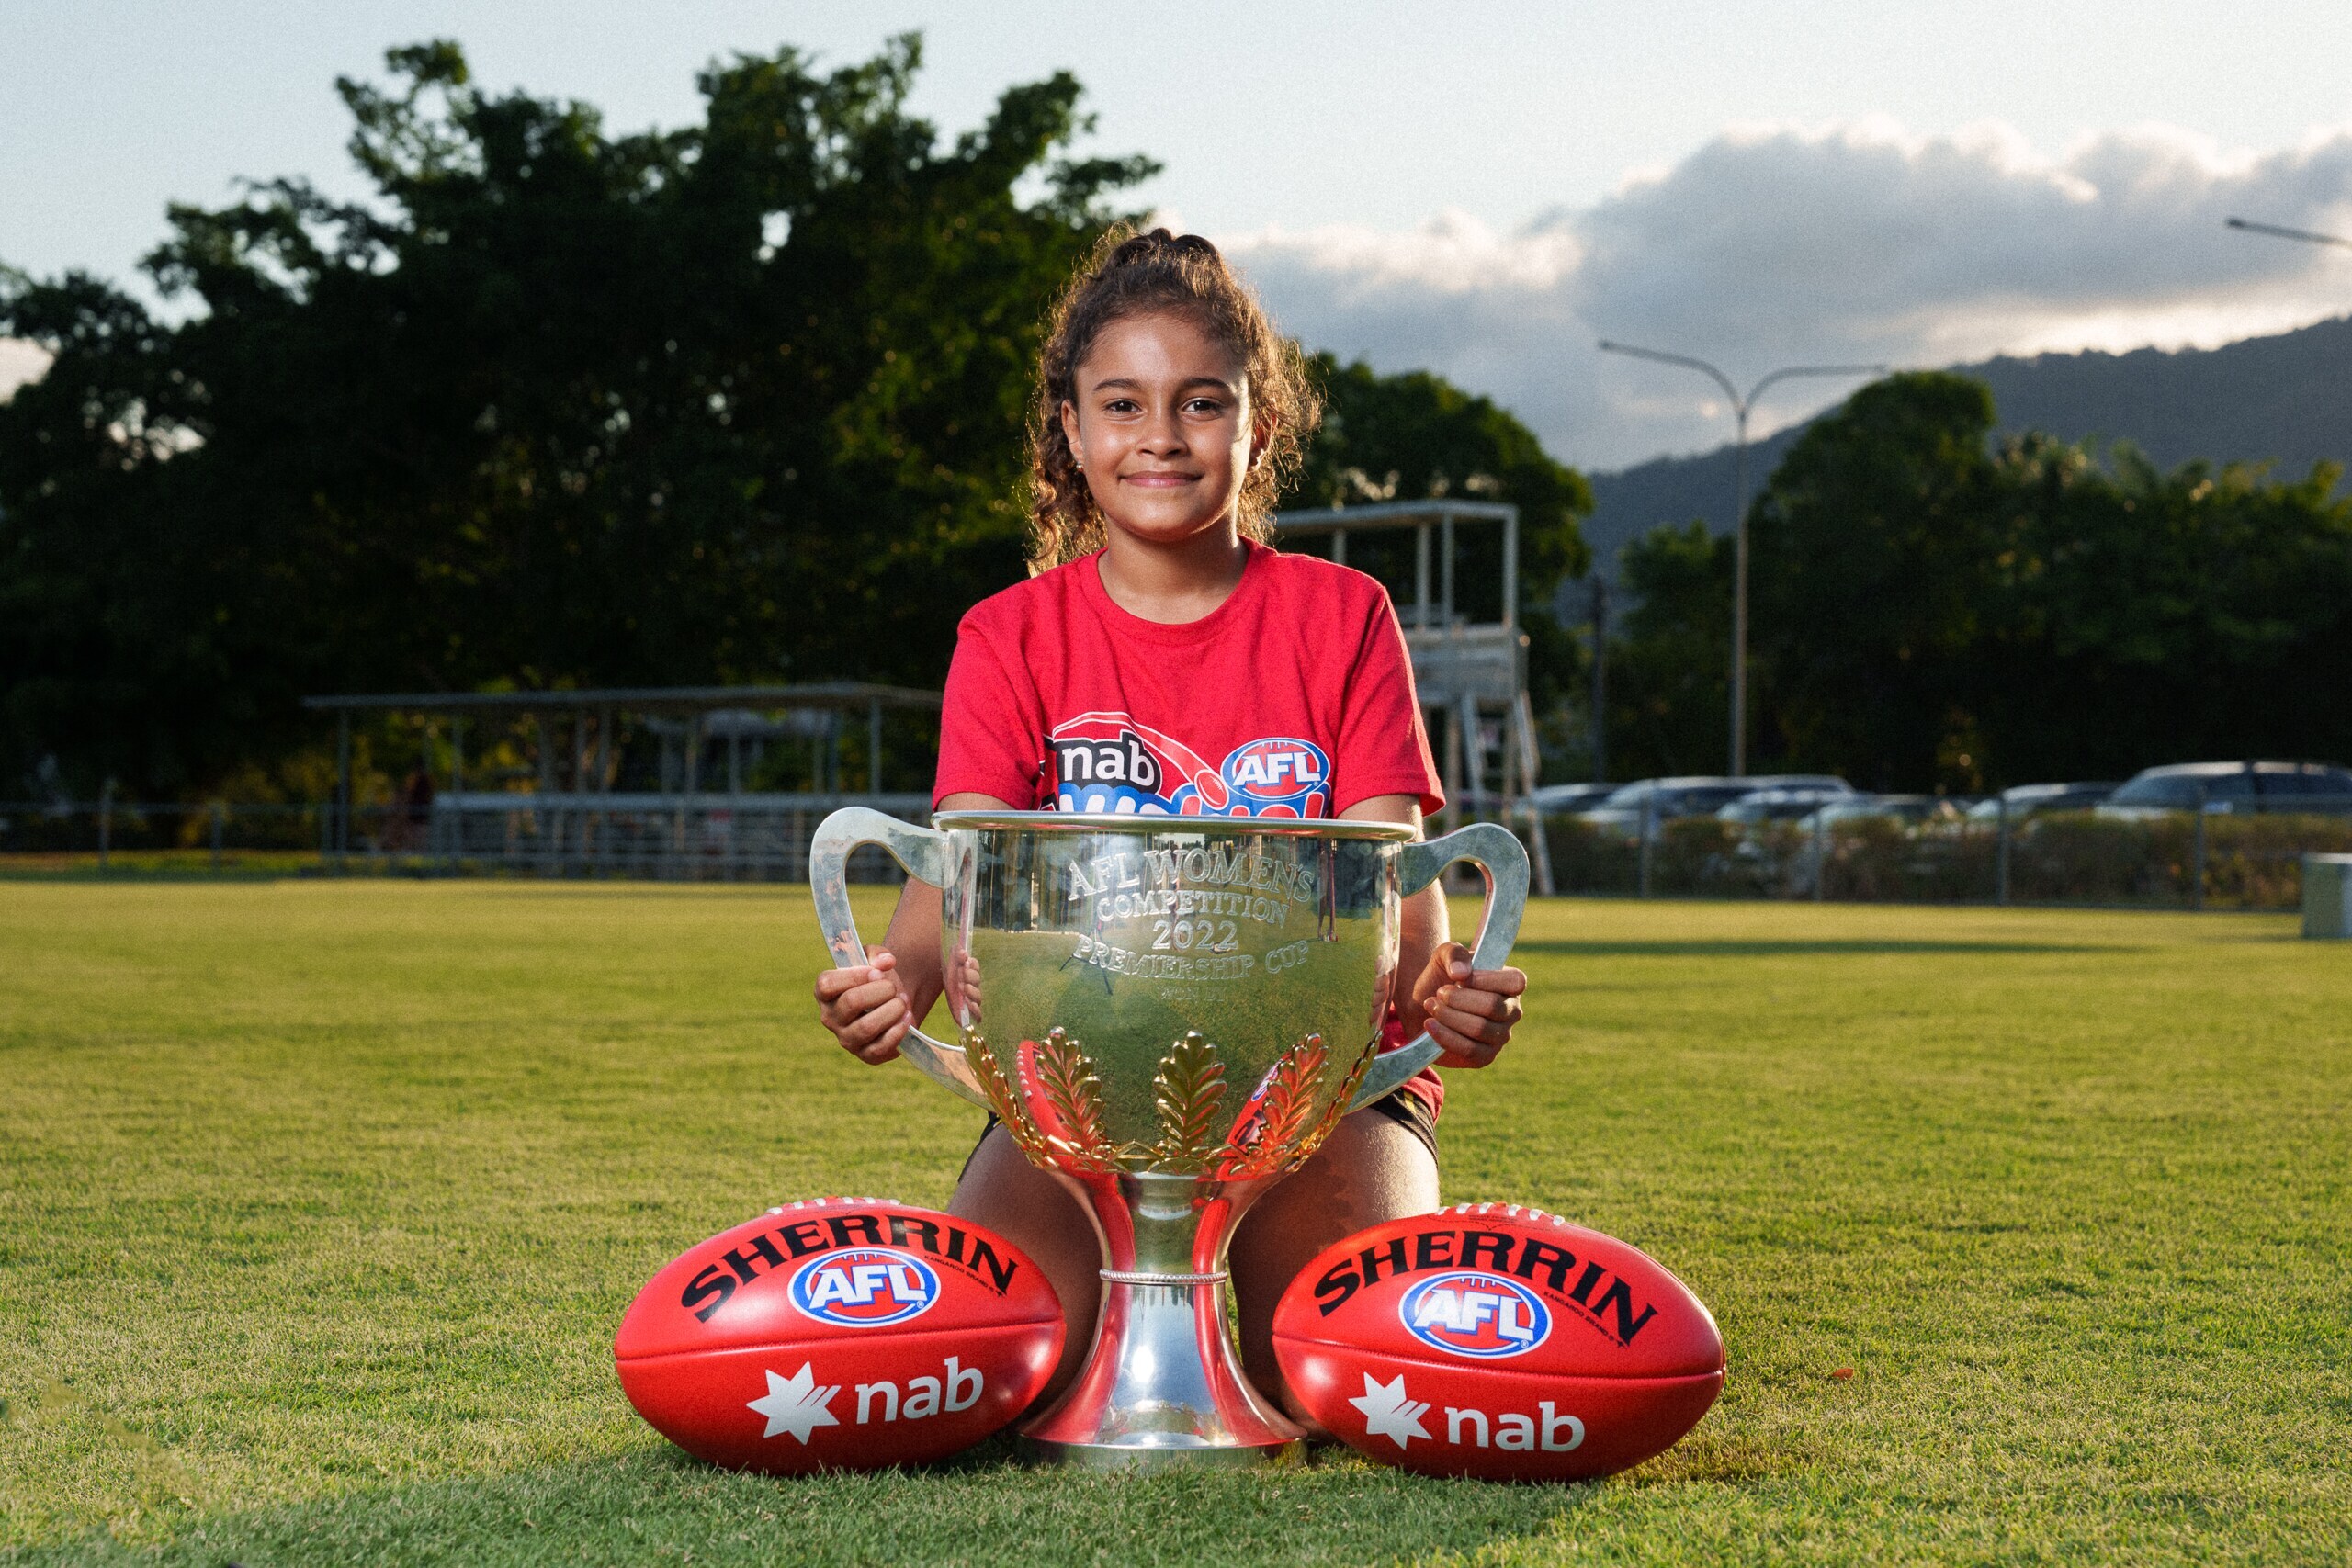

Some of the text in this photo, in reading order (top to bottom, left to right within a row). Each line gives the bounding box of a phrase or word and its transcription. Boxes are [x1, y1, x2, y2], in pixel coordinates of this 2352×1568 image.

[1060, 742, 1155, 786] nab
[1232, 751, 1321, 786] AFL
[1068, 848, 1314, 903] AFL WOMEN'S
[1097, 890, 1289, 928] COMPETITION
[1073, 933, 1308, 981] PREMIERSHIP CUP
[1152, 919, 1238, 950] 2022
[681, 1214, 1019, 1324] SHERRIN
[808, 1264, 927, 1309] AFL
[924, 1255, 965, 1274] KANGAROO
[1314, 1230, 1659, 1347] SHERRIN
[1544, 1292, 1585, 1318] KANGAROO
[1413, 1288, 1534, 1341] AFL
[855, 1356, 984, 1425] nab
[1444, 1401, 1585, 1452] nab
